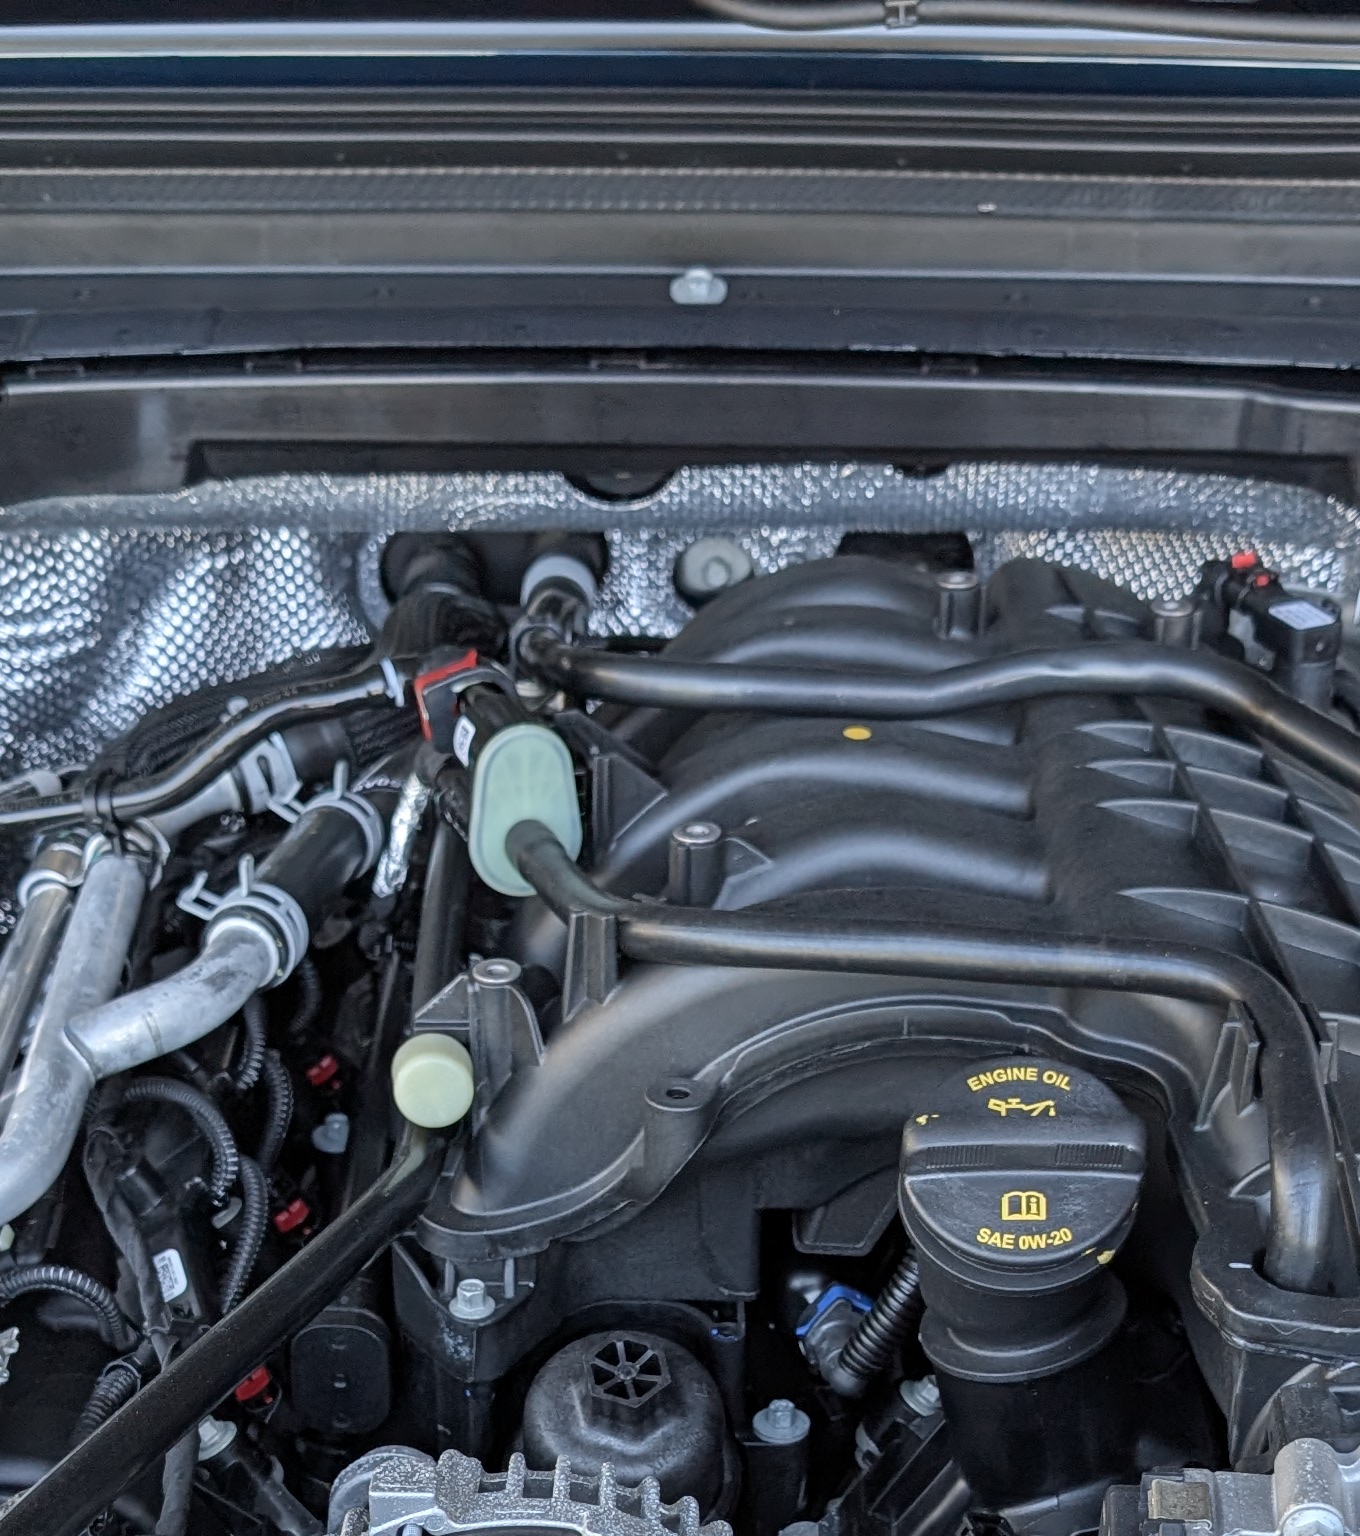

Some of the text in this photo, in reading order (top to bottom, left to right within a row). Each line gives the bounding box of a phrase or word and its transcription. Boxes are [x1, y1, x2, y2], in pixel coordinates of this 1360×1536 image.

[966, 1067, 1072, 1091] ENGINE OIL
[976, 1227, 1073, 1250] SAE 0W-20
